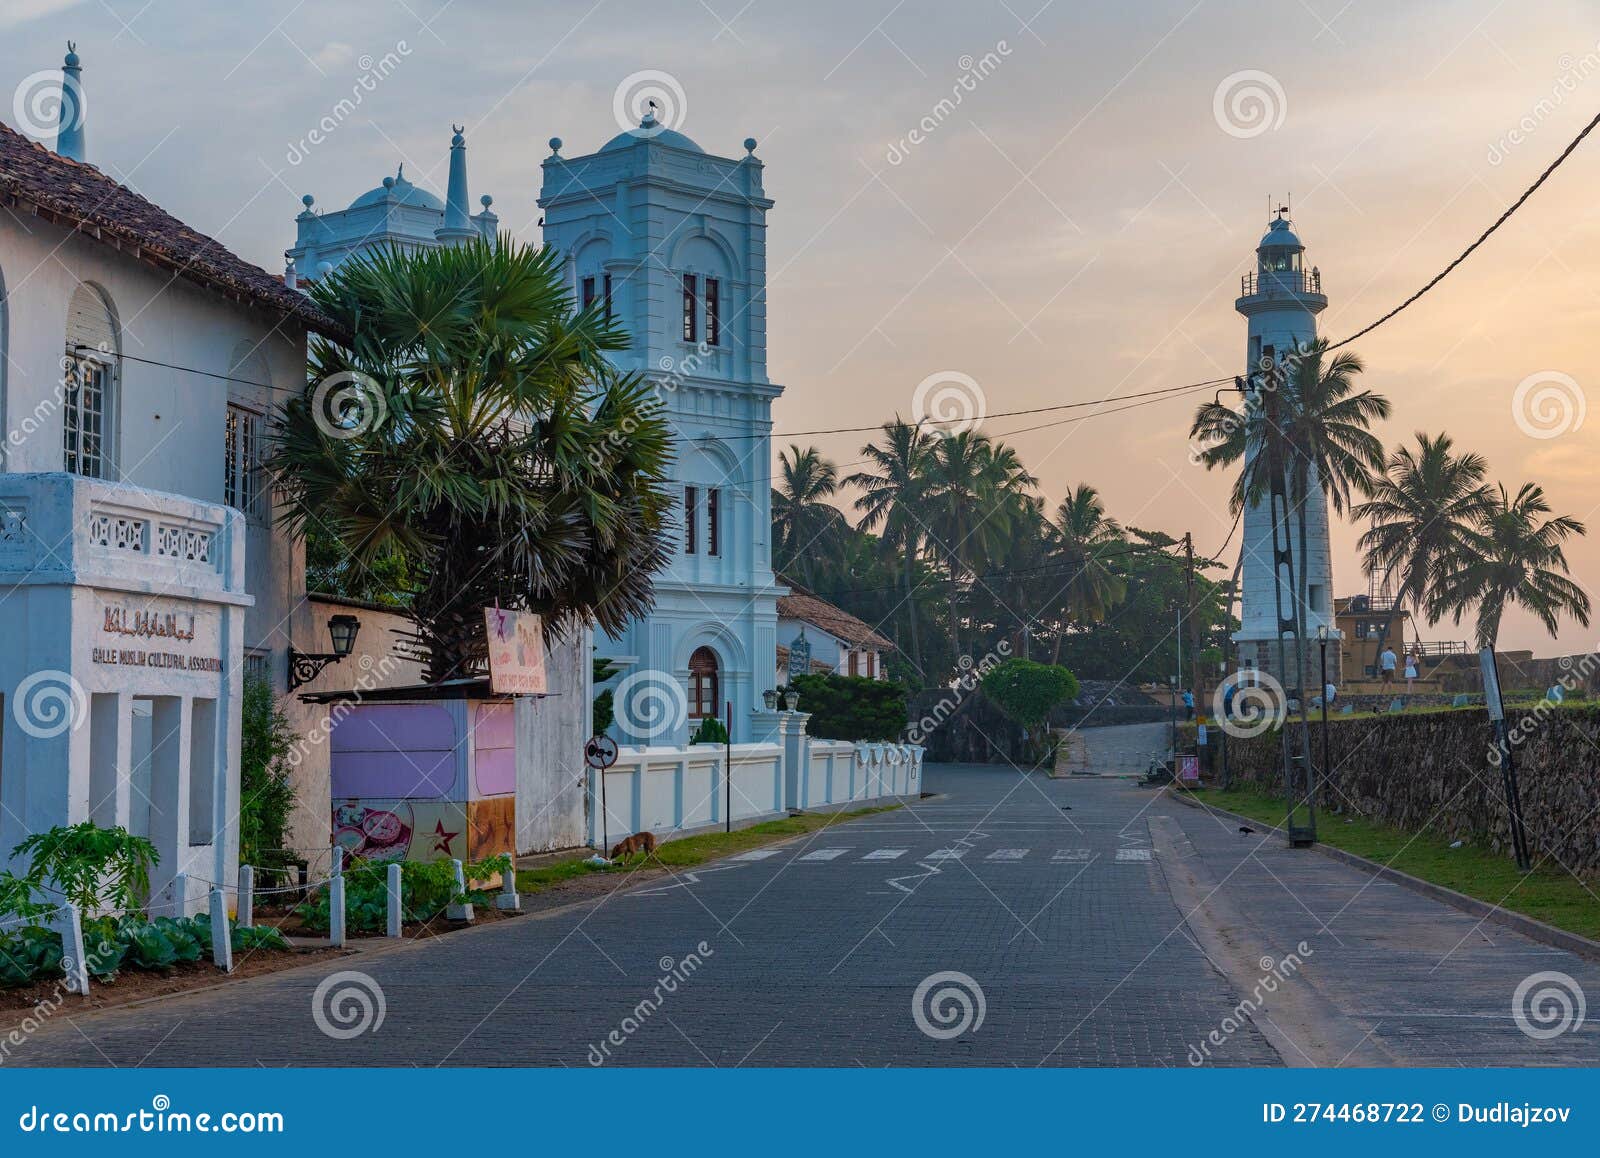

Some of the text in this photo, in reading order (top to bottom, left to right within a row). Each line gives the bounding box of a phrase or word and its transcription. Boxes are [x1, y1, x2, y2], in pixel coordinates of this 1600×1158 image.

[92, 648, 117, 664] GALLE
[119, 649, 146, 666] MUSLIM
[148, 652, 187, 670] CULTURAL
